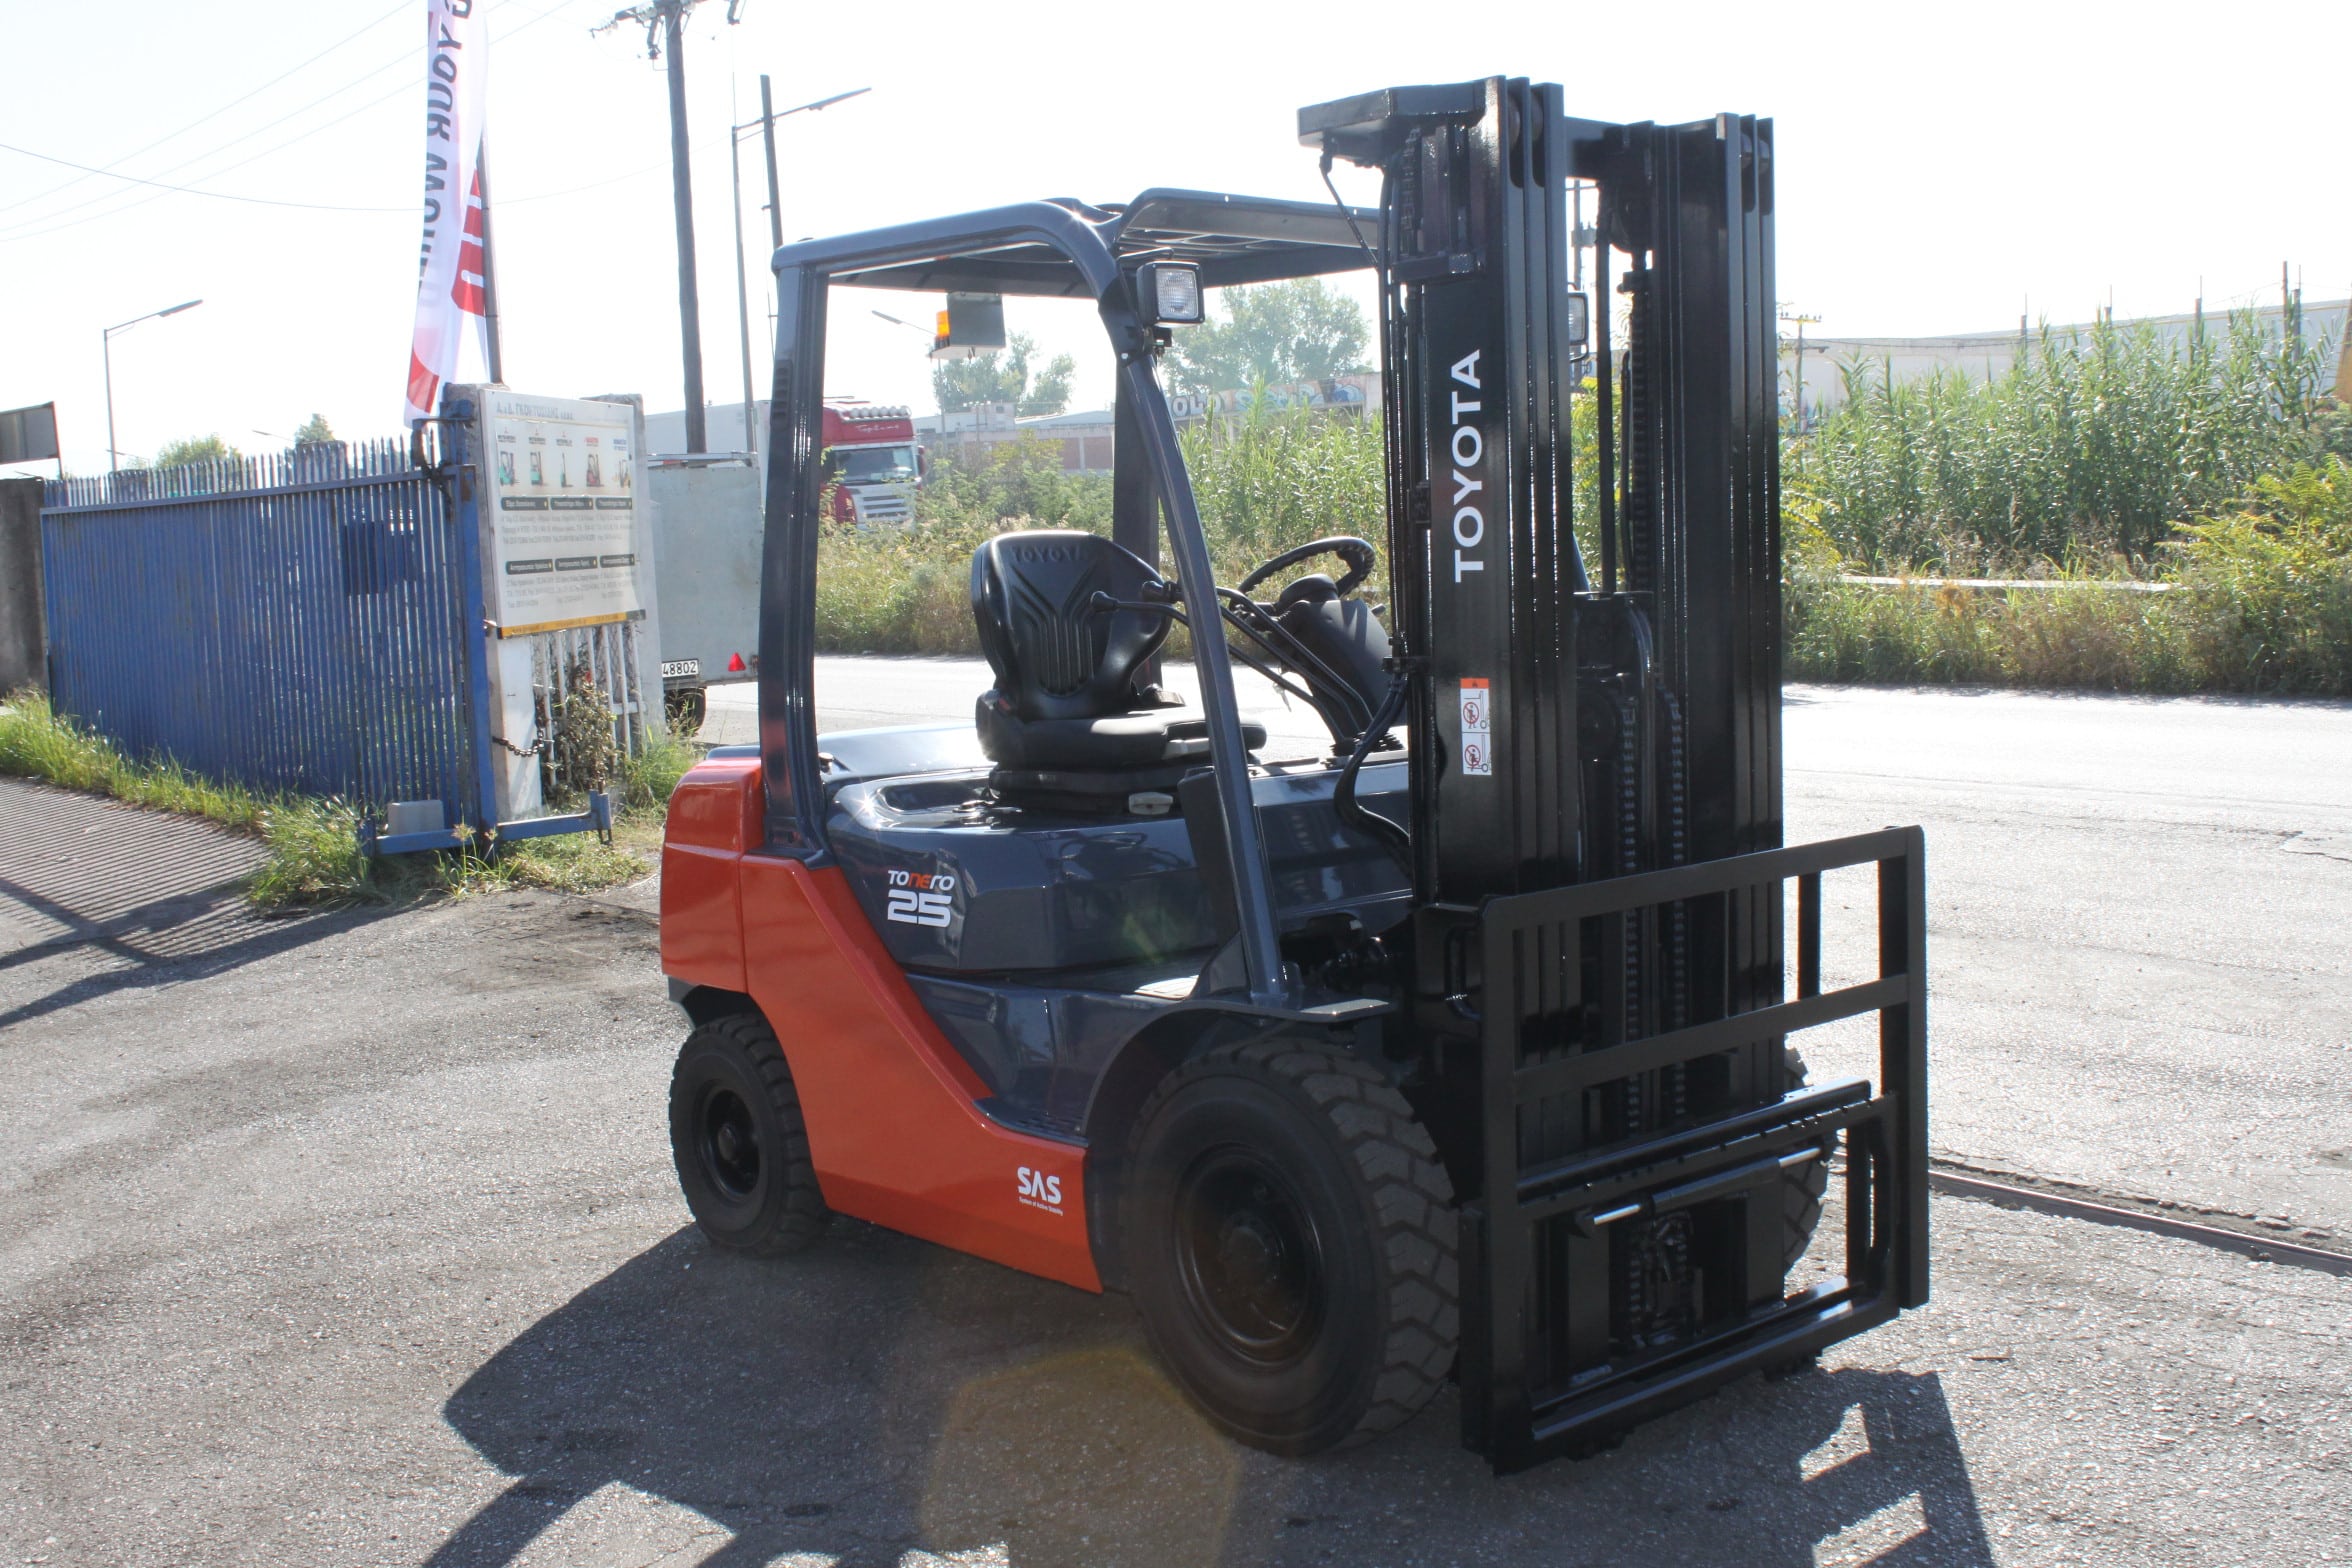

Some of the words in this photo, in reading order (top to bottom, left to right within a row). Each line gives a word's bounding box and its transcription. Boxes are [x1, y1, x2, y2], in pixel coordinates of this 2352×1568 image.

[1451, 349, 1484, 583] TOYOTA
[887, 889, 952, 928] 25
[1017, 1166, 1062, 1205] SAS
